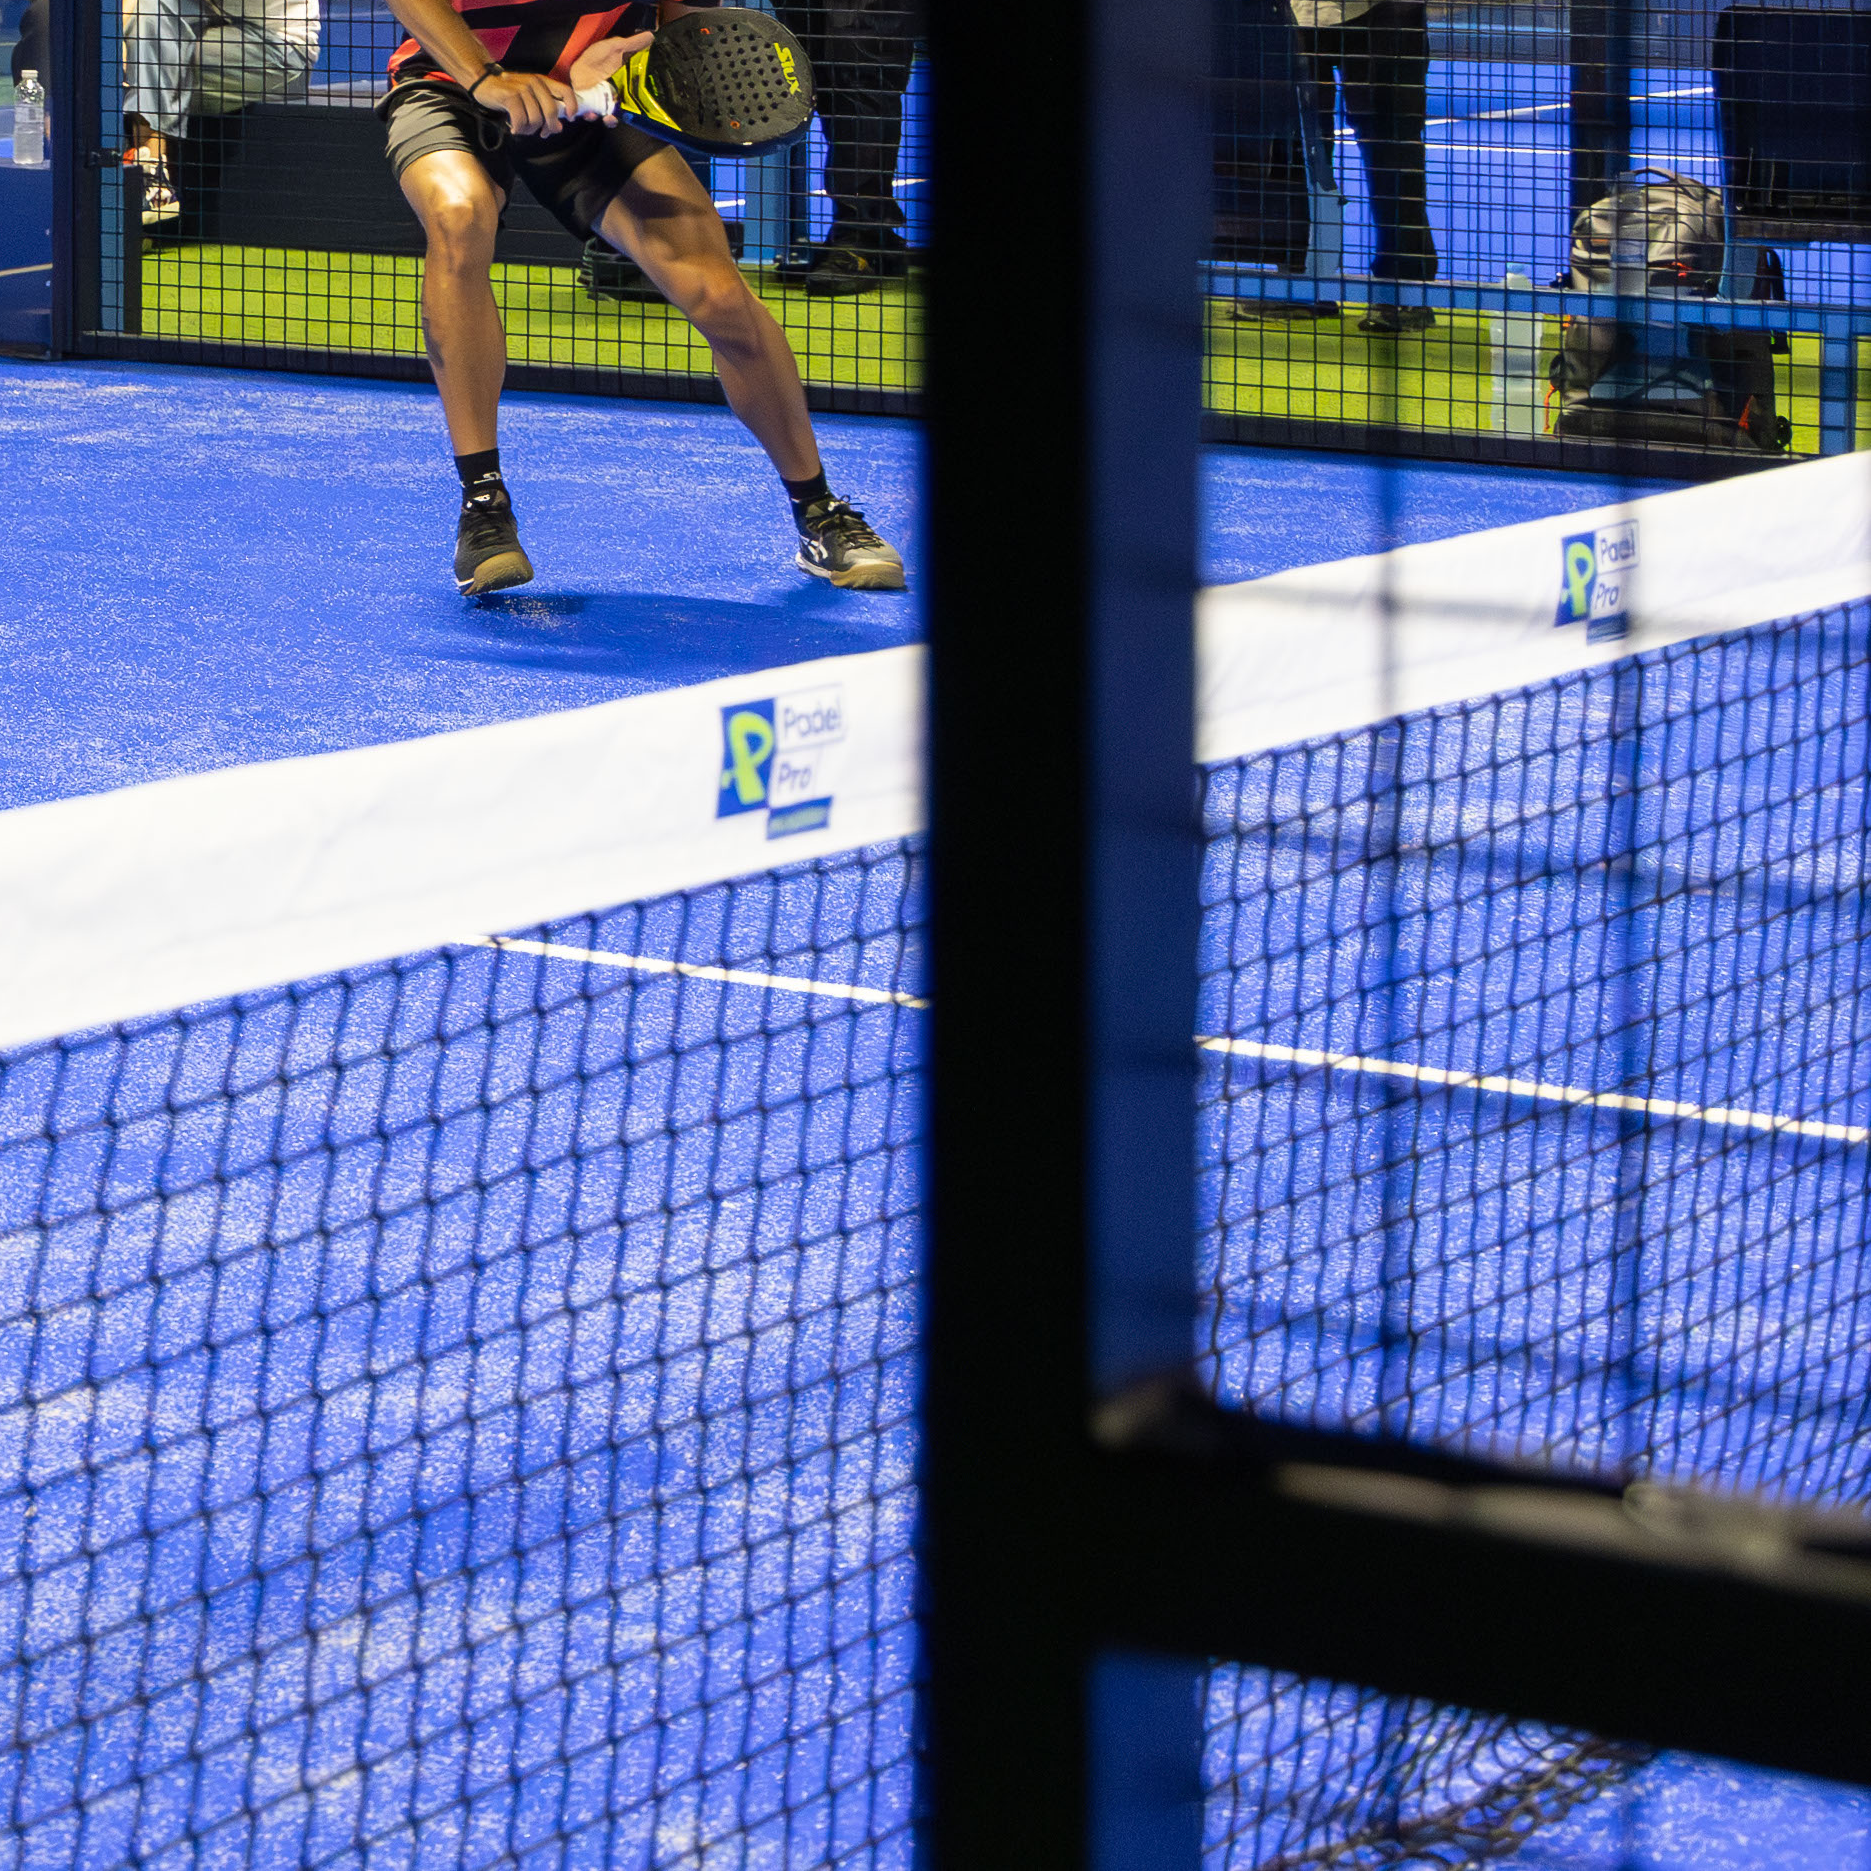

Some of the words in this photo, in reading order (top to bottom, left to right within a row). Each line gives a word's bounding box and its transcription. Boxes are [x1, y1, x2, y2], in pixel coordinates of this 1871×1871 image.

[773, 42, 802, 95] SIUX
[1594, 582, 1619, 609] Pro
[783, 695, 842, 741] Padel
[778, 761, 812, 794] Pro
